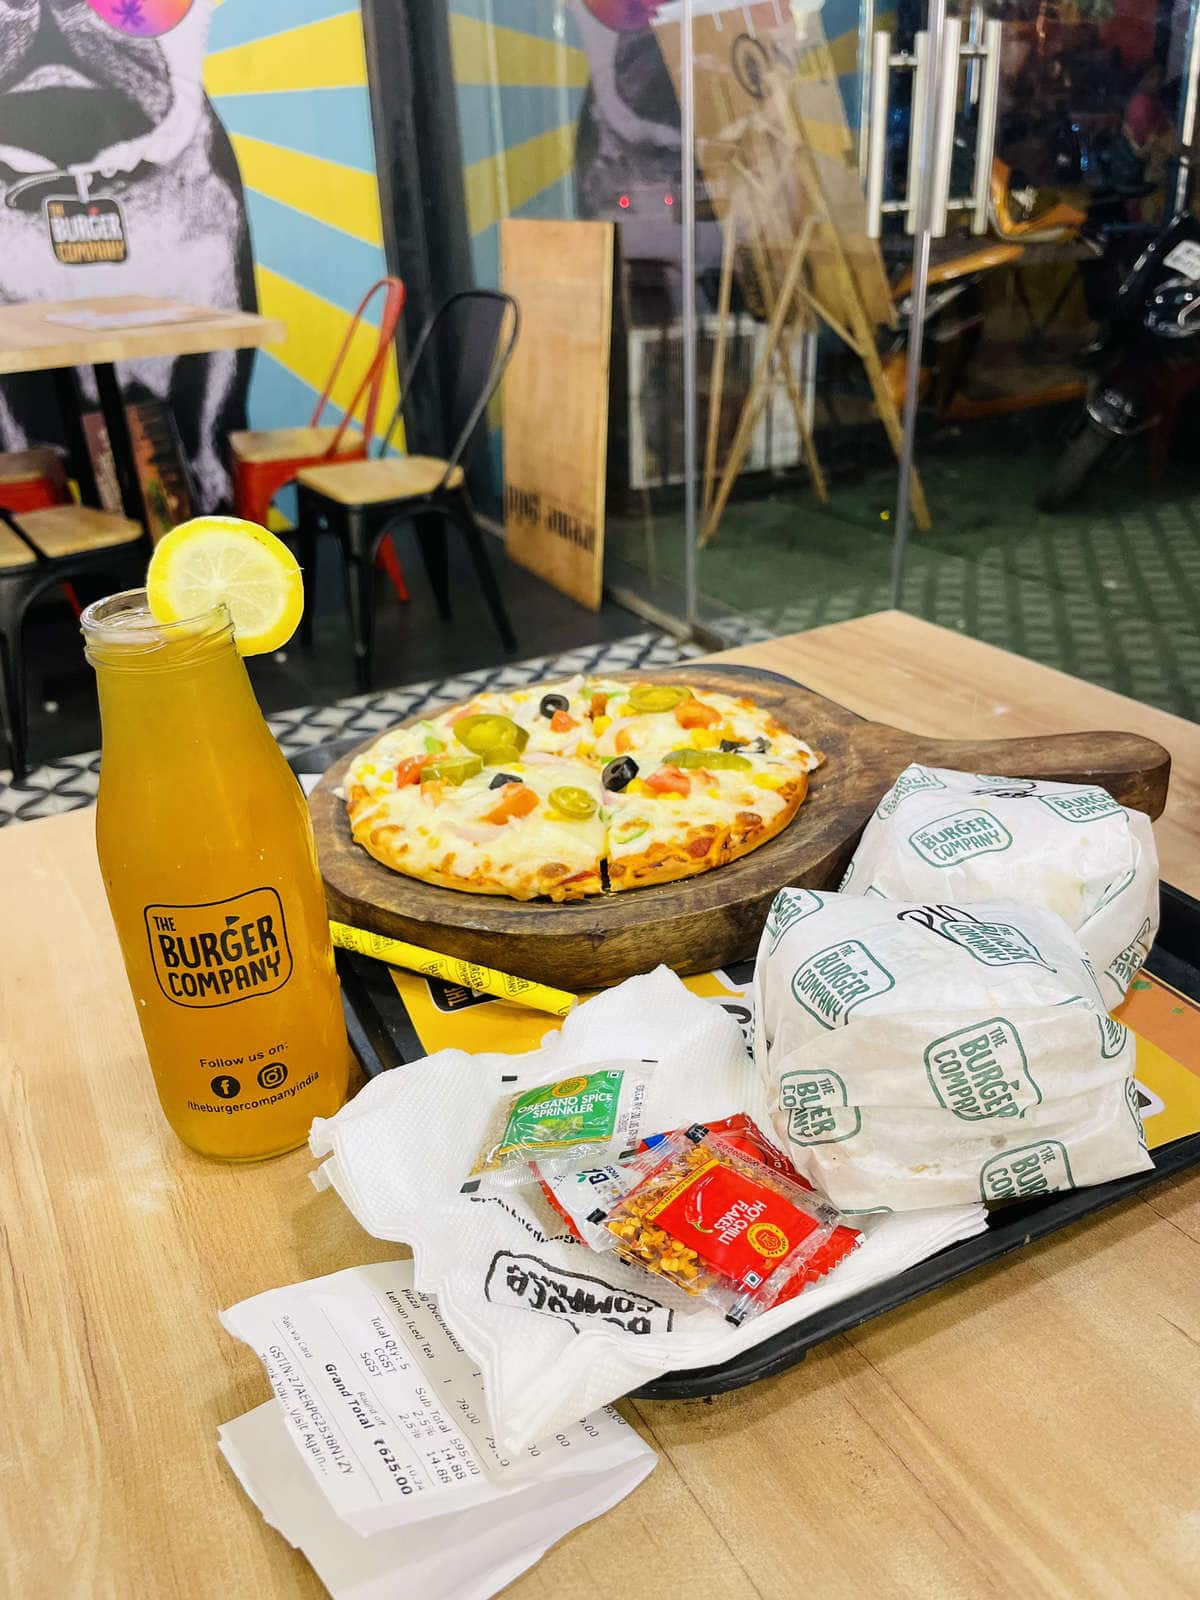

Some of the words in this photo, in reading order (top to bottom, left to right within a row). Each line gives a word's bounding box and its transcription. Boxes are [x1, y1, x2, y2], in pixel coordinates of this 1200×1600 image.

[1067, 801, 1120, 819] COMPA
[921, 816, 993, 850] BURGER
[933, 829, 1003, 862] COMPANY
[152, 915, 177, 932] THE
[158, 914, 279, 969] BURGER
[838, 944, 855, 957] THE
[167, 950, 281, 998] COMPANY
[812, 951, 870, 1004] BURGER
[797, 968, 844, 1023] COMPANY
[988, 1026, 1008, 1049] THE
[200, 1057, 244, 1069] Follow
[248, 1051, 265, 1063] us
[268, 1041, 289, 1056] on:
[187, 1071, 320, 1115] /theburgercompanyindia
[517, 1096, 578, 1114] OREGANO
[581, 1092, 614, 1106] SPICE
[817, 1077, 836, 1096] THE
[532, 1103, 594, 1119] SPRINKLER
[1039, 1145, 1056, 1164] THE
[713, 1198, 747, 1232] FLAKES
[744, 1200, 768, 1222] HOT
[718, 1219, 748, 1246] CHILLI
[401, 1287, 421, 1310] Pizza
[384, 1290, 409, 1320] Lemon
[406, 1320, 425, 1341] Iced
[421, 1340, 435, 1360] Tea
[370, 1315, 391, 1340] Total
[385, 1339, 403, 1361] Qty:
[399, 1362, 410, 1371] 5
[325, 1362, 353, 1398] Grand
[348, 1399, 375, 1430] Total
[456, 1397, 481, 1425] 79.00
[360, 1351, 382, 1377] SGST
[426, 1450, 452, 1484] 14.88
[373, 1346, 398, 1374] CGST
[412, 1409, 435, 1437] 2.5%
[441, 1446, 467, 1480] 14.88
[414, 1386, 432, 1408] Sub
[429, 1409, 452, 1434] Total
[449, 1437, 481, 1476] 595.00
